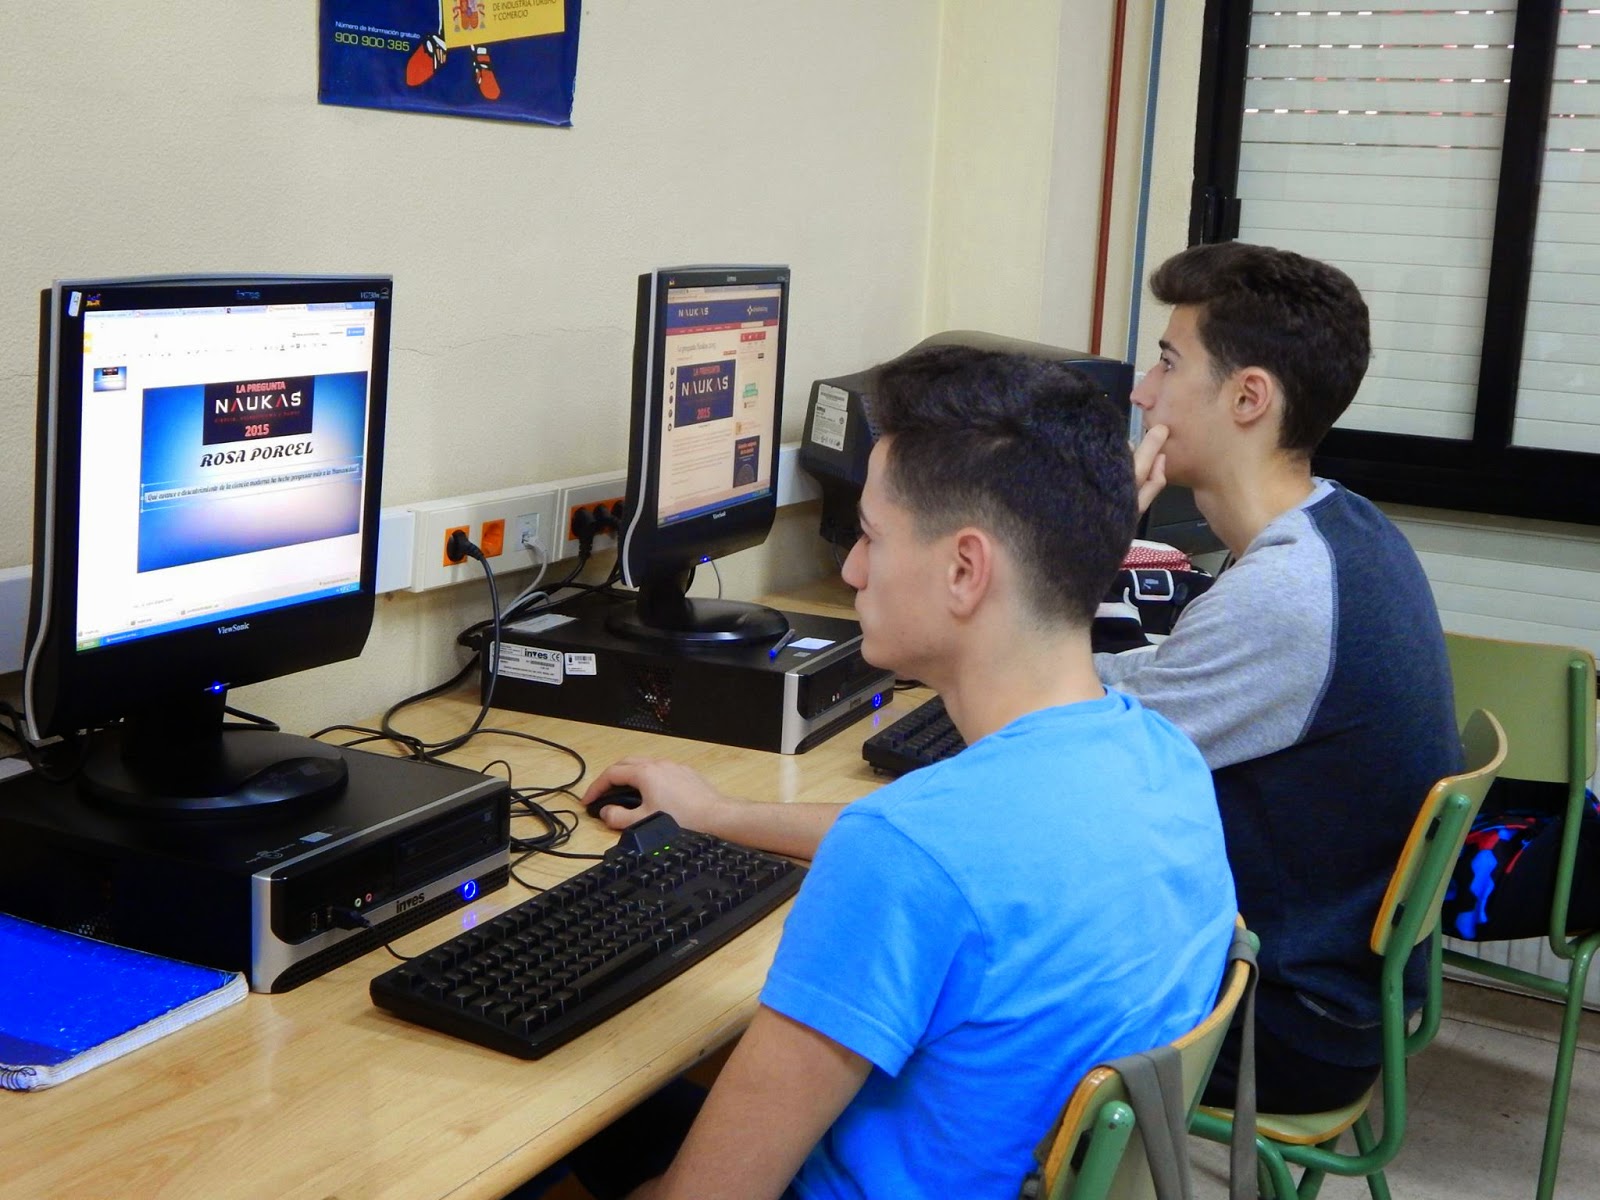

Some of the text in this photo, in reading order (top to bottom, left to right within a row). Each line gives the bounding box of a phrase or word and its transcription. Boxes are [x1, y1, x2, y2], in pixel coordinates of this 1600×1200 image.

[492, 3, 500, 11] DE
[498, 9, 529, 21] COMERCIO
[335, 21, 359, 30] Número
[400, 31, 421, 39] gratuito
[335, 32, 410, 51] 900 900 385
[236, 381, 286, 394] LA PREGUNTA
[681, 375, 729, 397] NAUKAS
[215, 390, 302, 414] NAUKAS
[245, 423, 270, 437] 2015
[200, 441, 314, 467] ROSA PORCEL
[218, 622, 250, 634] ViewSonic
[524, 649, 548, 660] inves
[396, 893, 425, 914] inves
